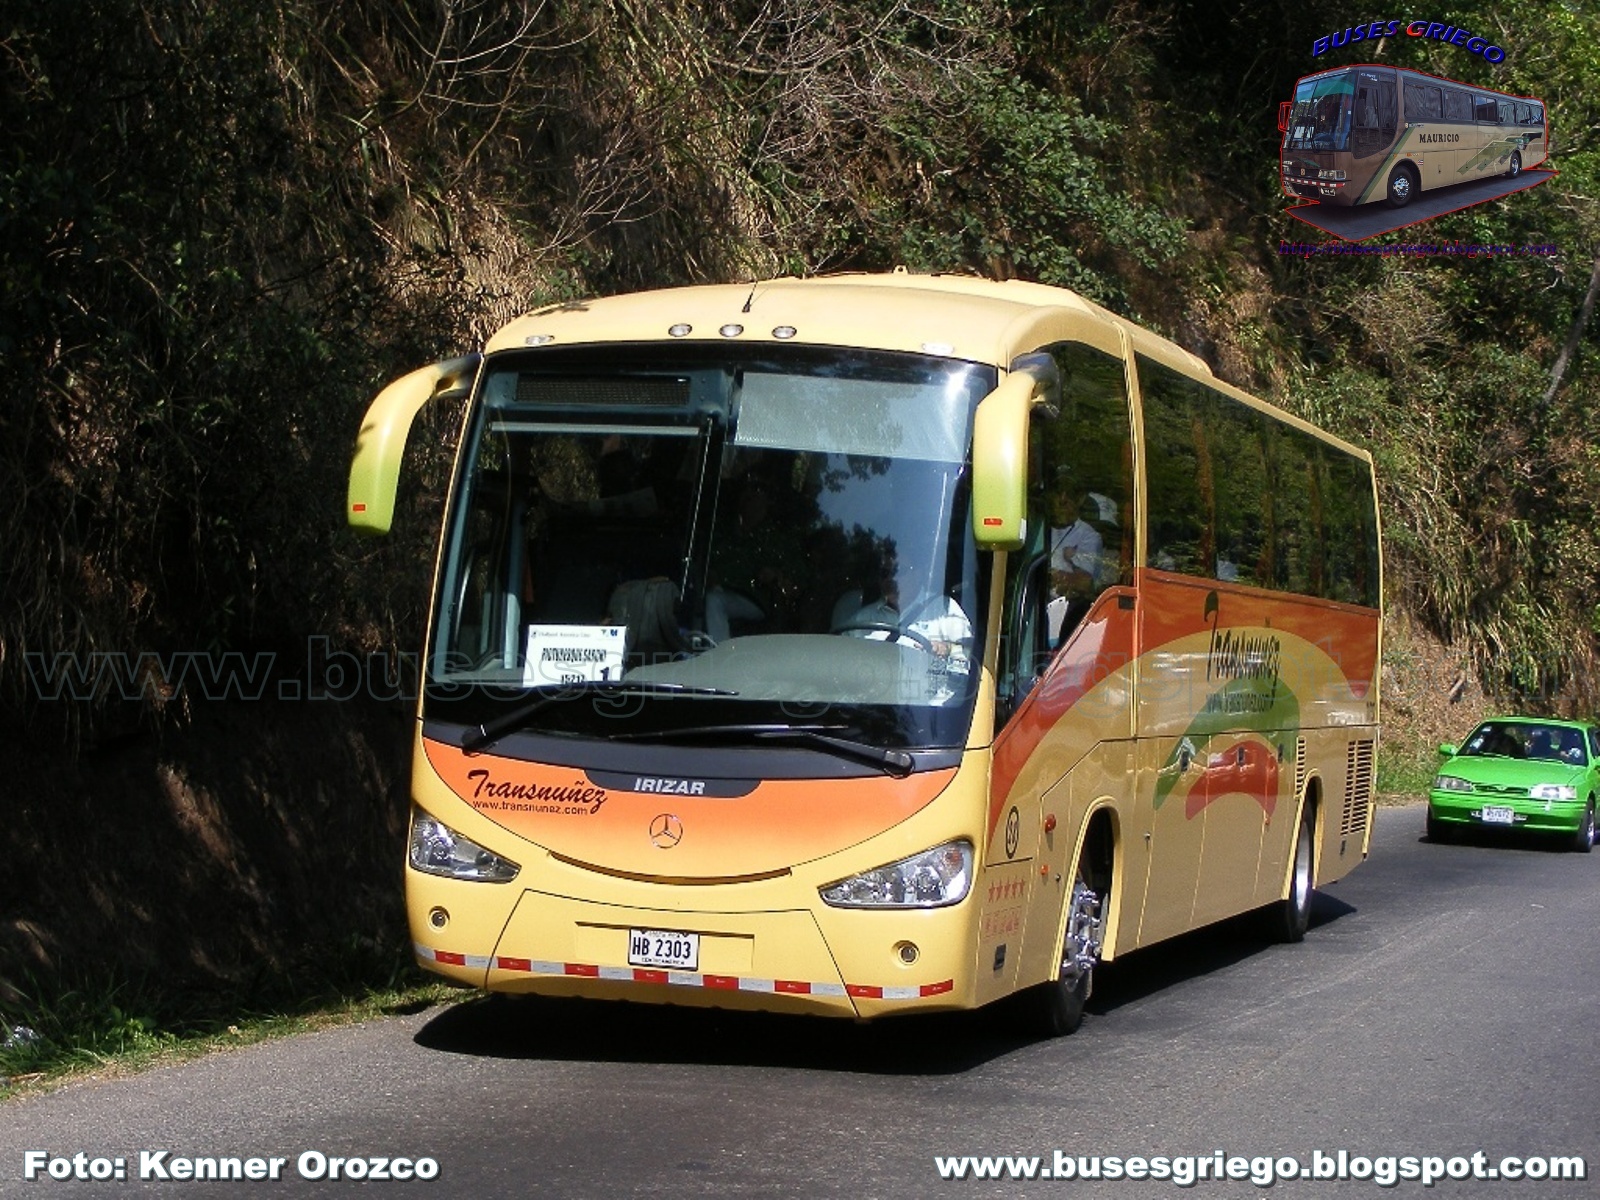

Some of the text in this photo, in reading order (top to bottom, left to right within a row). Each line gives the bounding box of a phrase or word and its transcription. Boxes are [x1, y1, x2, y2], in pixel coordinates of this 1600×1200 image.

[468, 769, 608, 814] Transnuñez
[634, 777, 705, 795] IRIZAR
[473, 799, 588, 815] www.transnunez.com
[632, 936, 691, 960] HB 2303
